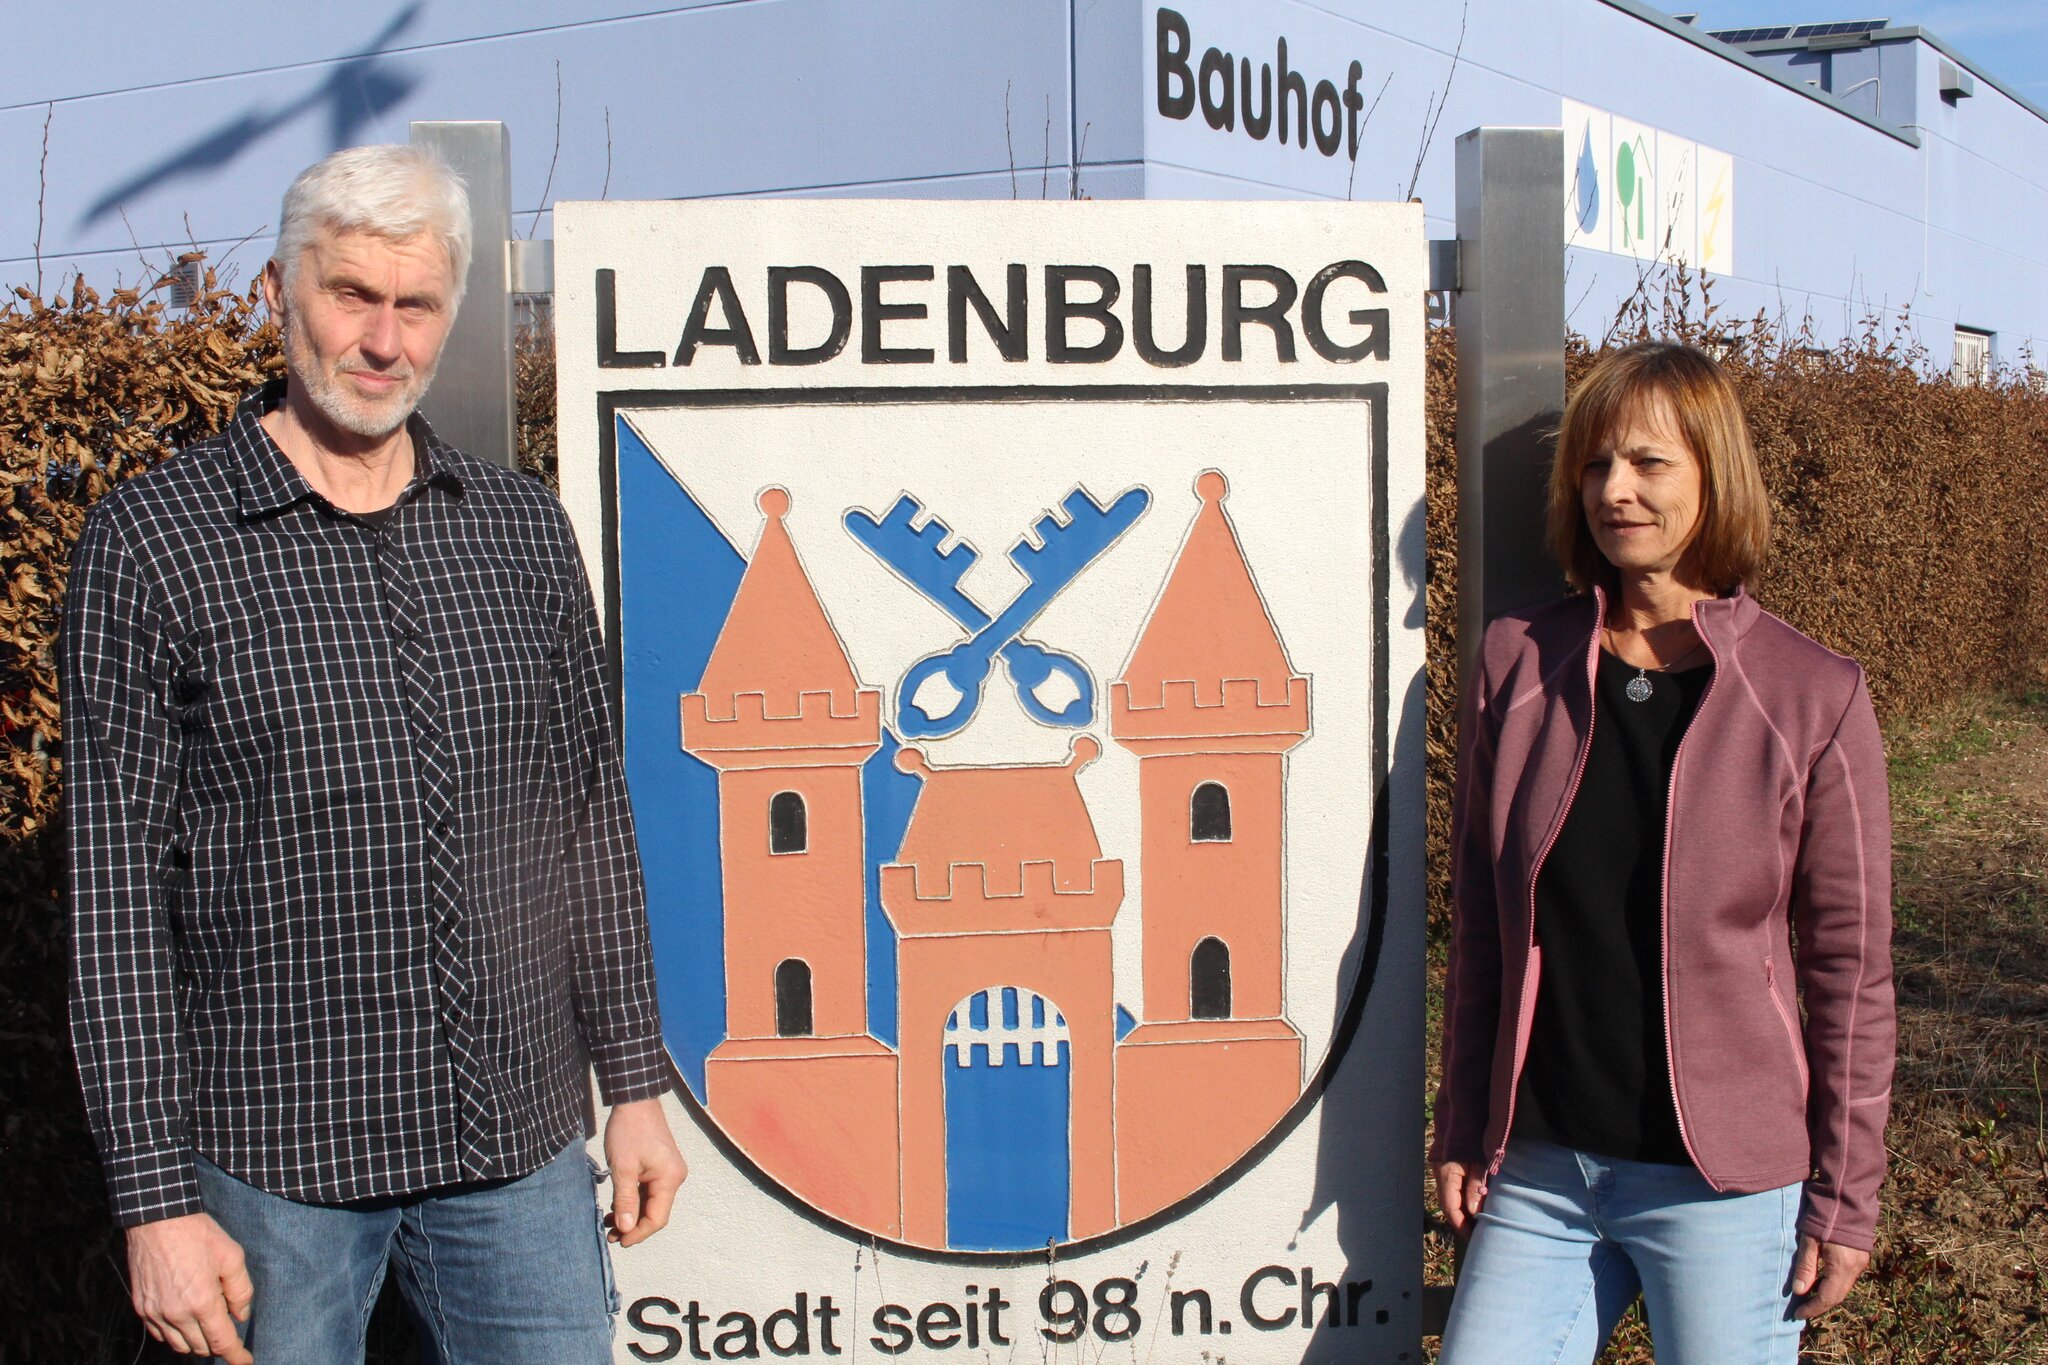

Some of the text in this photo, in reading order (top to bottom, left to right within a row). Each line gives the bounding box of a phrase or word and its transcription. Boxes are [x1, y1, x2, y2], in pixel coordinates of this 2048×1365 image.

[1157, 7, 1363, 162] Bauhof
[596, 260, 1390, 369] LADENBURG
[626, 1292, 842, 1363] Stadt
[870, 1285, 1010, 1355] seit
[1039, 1277, 1141, 1344] 98
